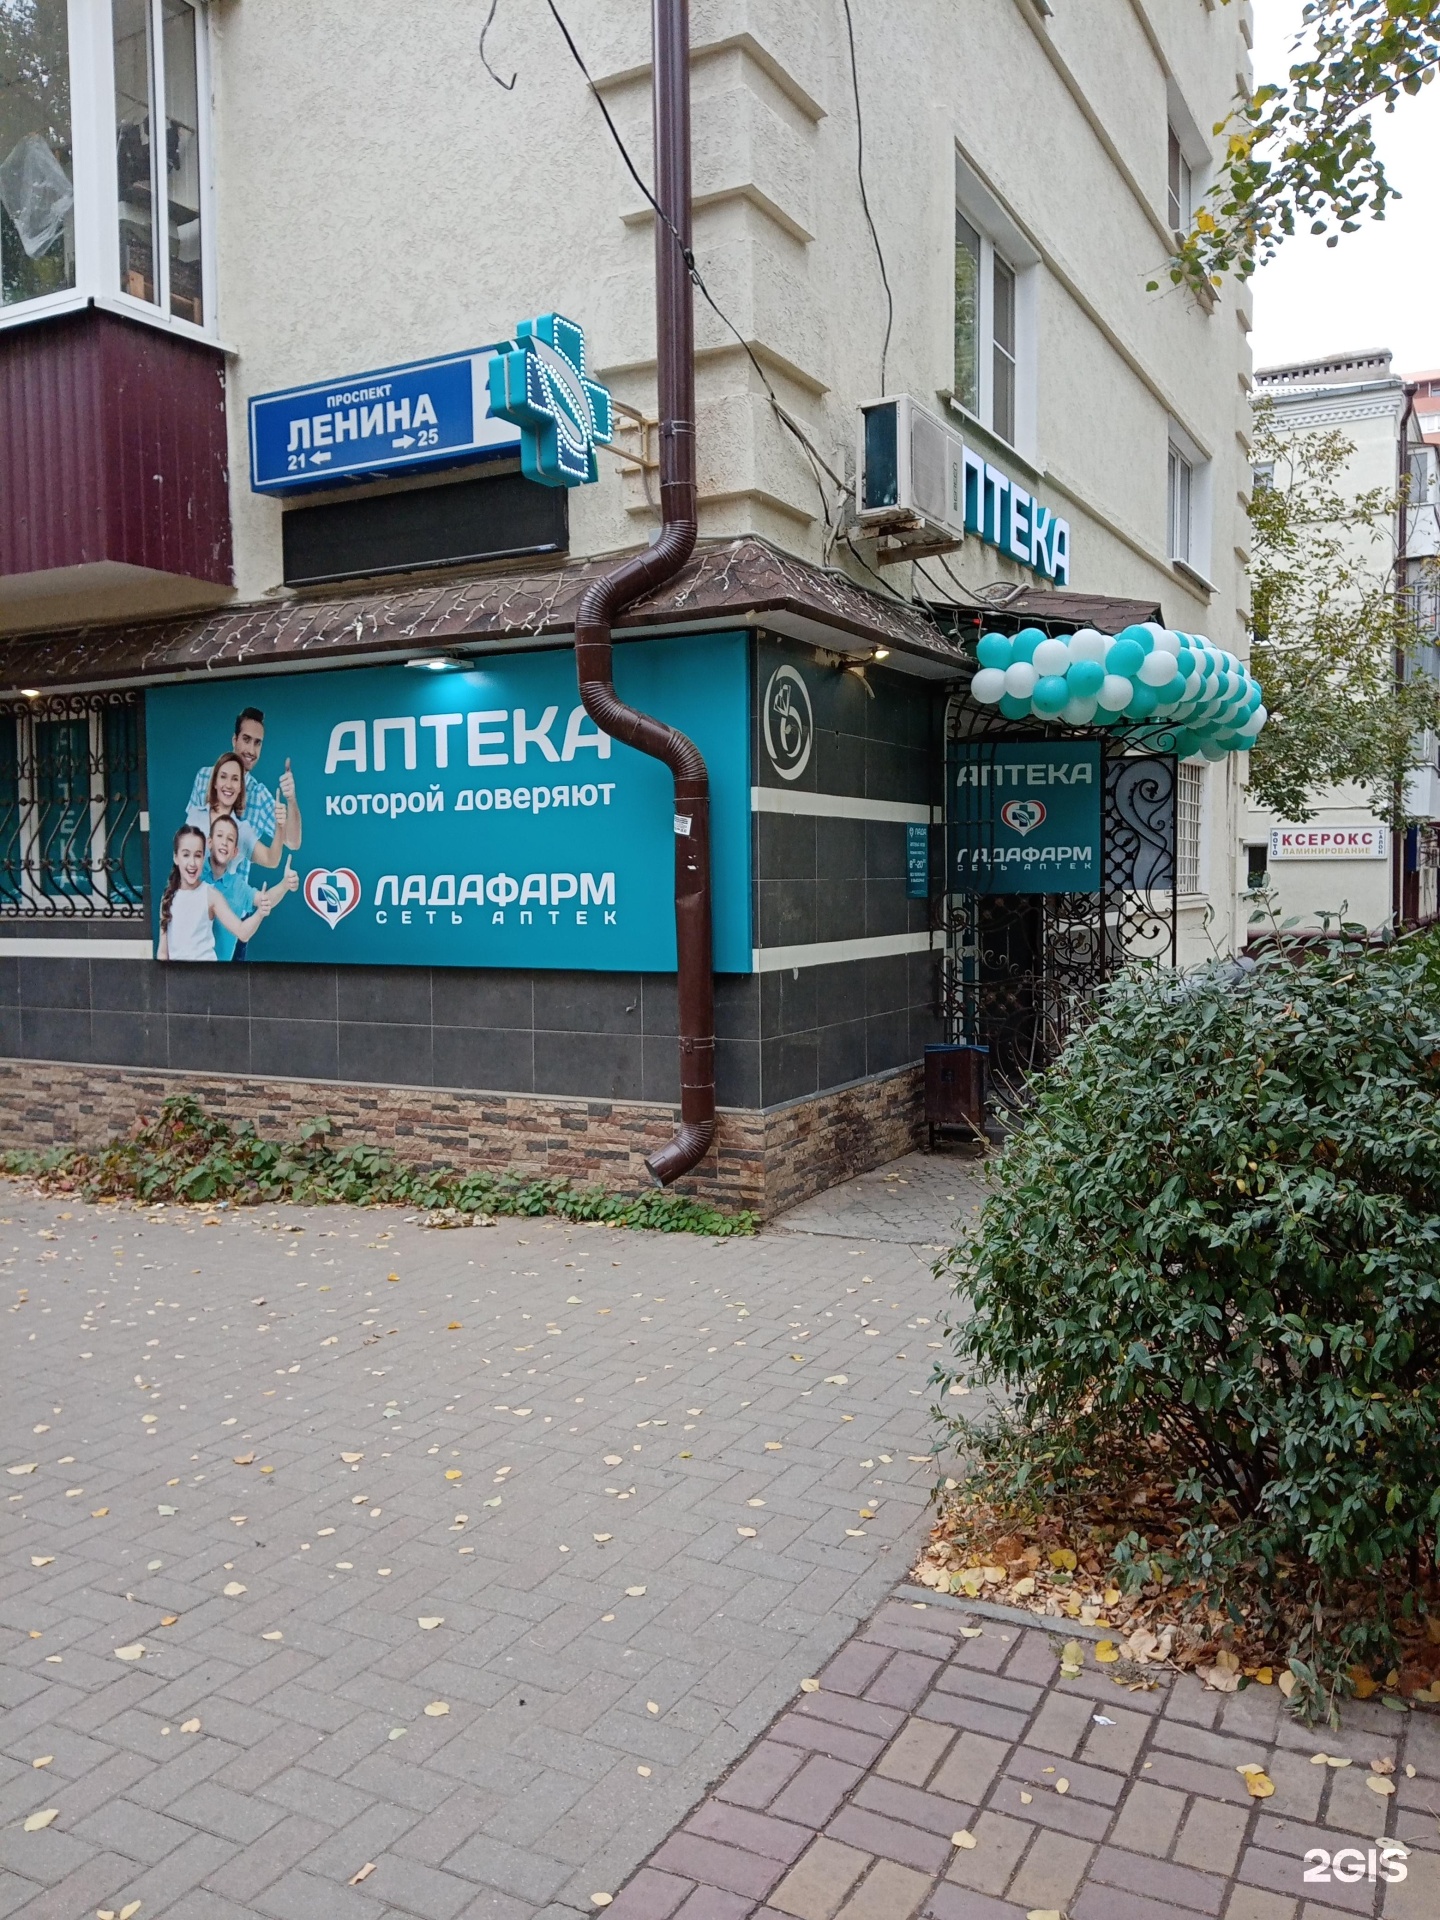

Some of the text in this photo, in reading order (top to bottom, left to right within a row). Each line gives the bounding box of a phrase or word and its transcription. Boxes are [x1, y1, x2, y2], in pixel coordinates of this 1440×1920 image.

[326, 384, 392, 408] ПРОСПЕКТ
[287, 393, 438, 452] ЛЕНИНА
[417, 428, 439, 447] 25
[287, 451, 306, 471] 21
[963, 444, 1070, 586] ПТЕКА
[324, 705, 612, 775] АПТЕКА
[956, 763, 1093, 787] АПТЕКА
[325, 783, 616, 819] которой доверяют
[1282, 832, 1373, 846] КСЕРОКС
[1282, 847, 1371, 855] ЛАМИНИРОВАНИЕ
[957, 862, 1092, 872] СЕТЬ АПТЕК
[374, 872, 616, 907] ЛАДАФАРМ
[375, 910, 617, 926] СЕТЬ АПТЕК
